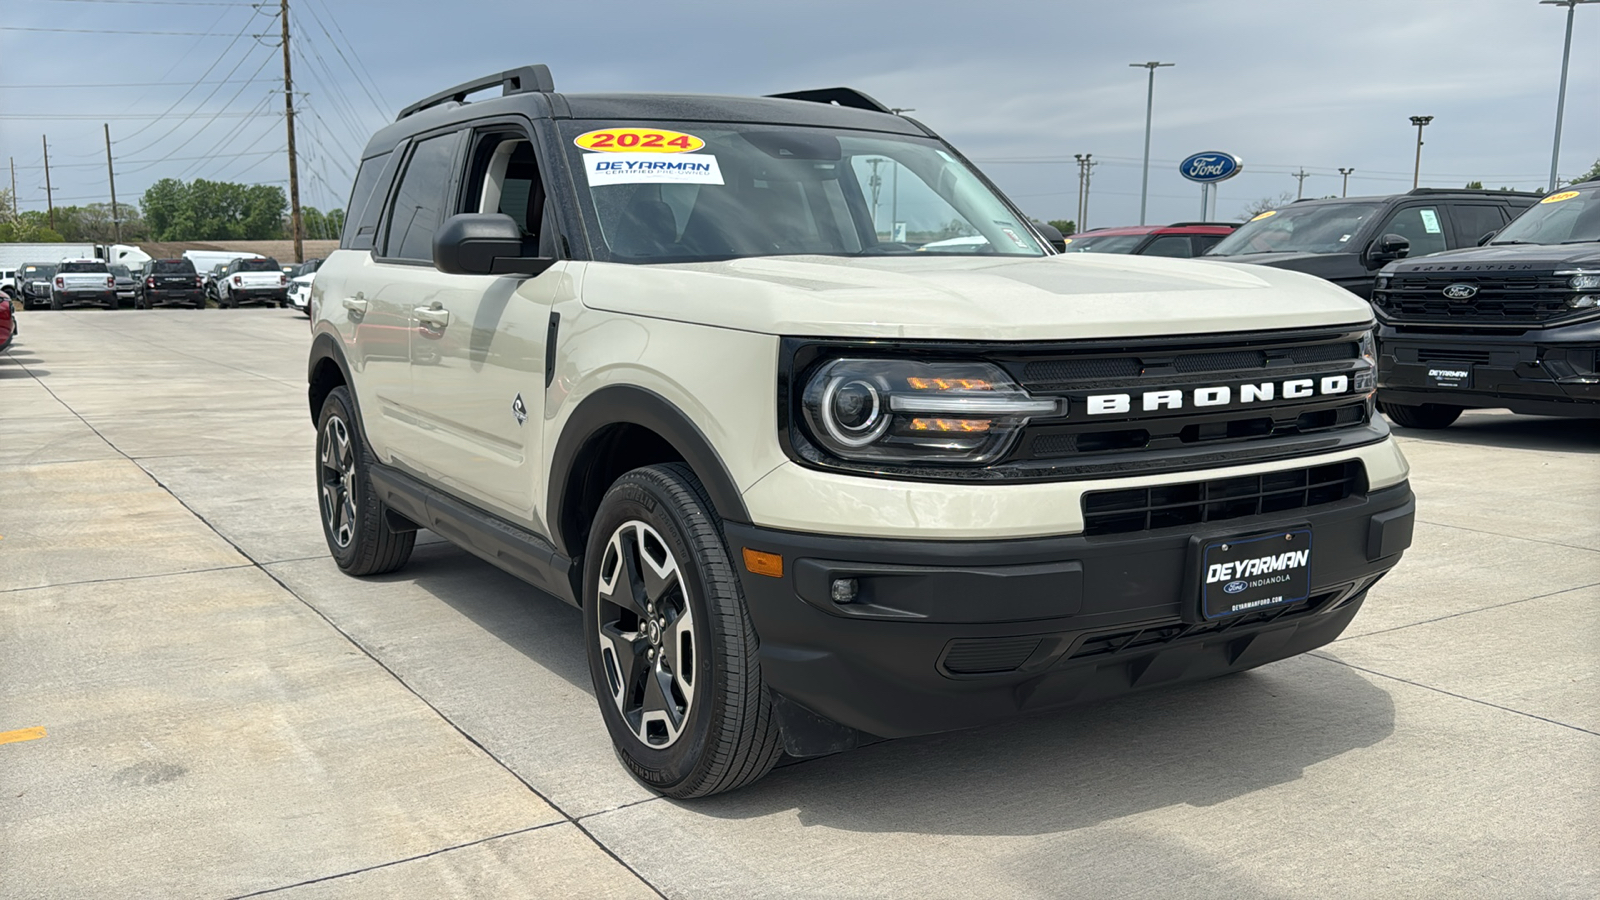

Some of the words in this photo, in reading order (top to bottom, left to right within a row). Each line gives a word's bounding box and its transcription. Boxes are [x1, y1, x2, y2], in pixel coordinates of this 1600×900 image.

[590, 133, 692, 149] 2024
[596, 161, 710, 172] DEYARMAN
[1189, 156, 1226, 177] Ford
[1411, 264, 1533, 272] EXPEDITION
[1448, 286, 1470, 298] Ford
[1428, 368, 1469, 378] DEYARMAN
[1087, 374, 1349, 416] BRONCO
[1206, 549, 1310, 584] DEYARMAN
[1249, 573, 1291, 588] INDIANOLA
[1232, 596, 1283, 612] DEYARMANFORD.COM
